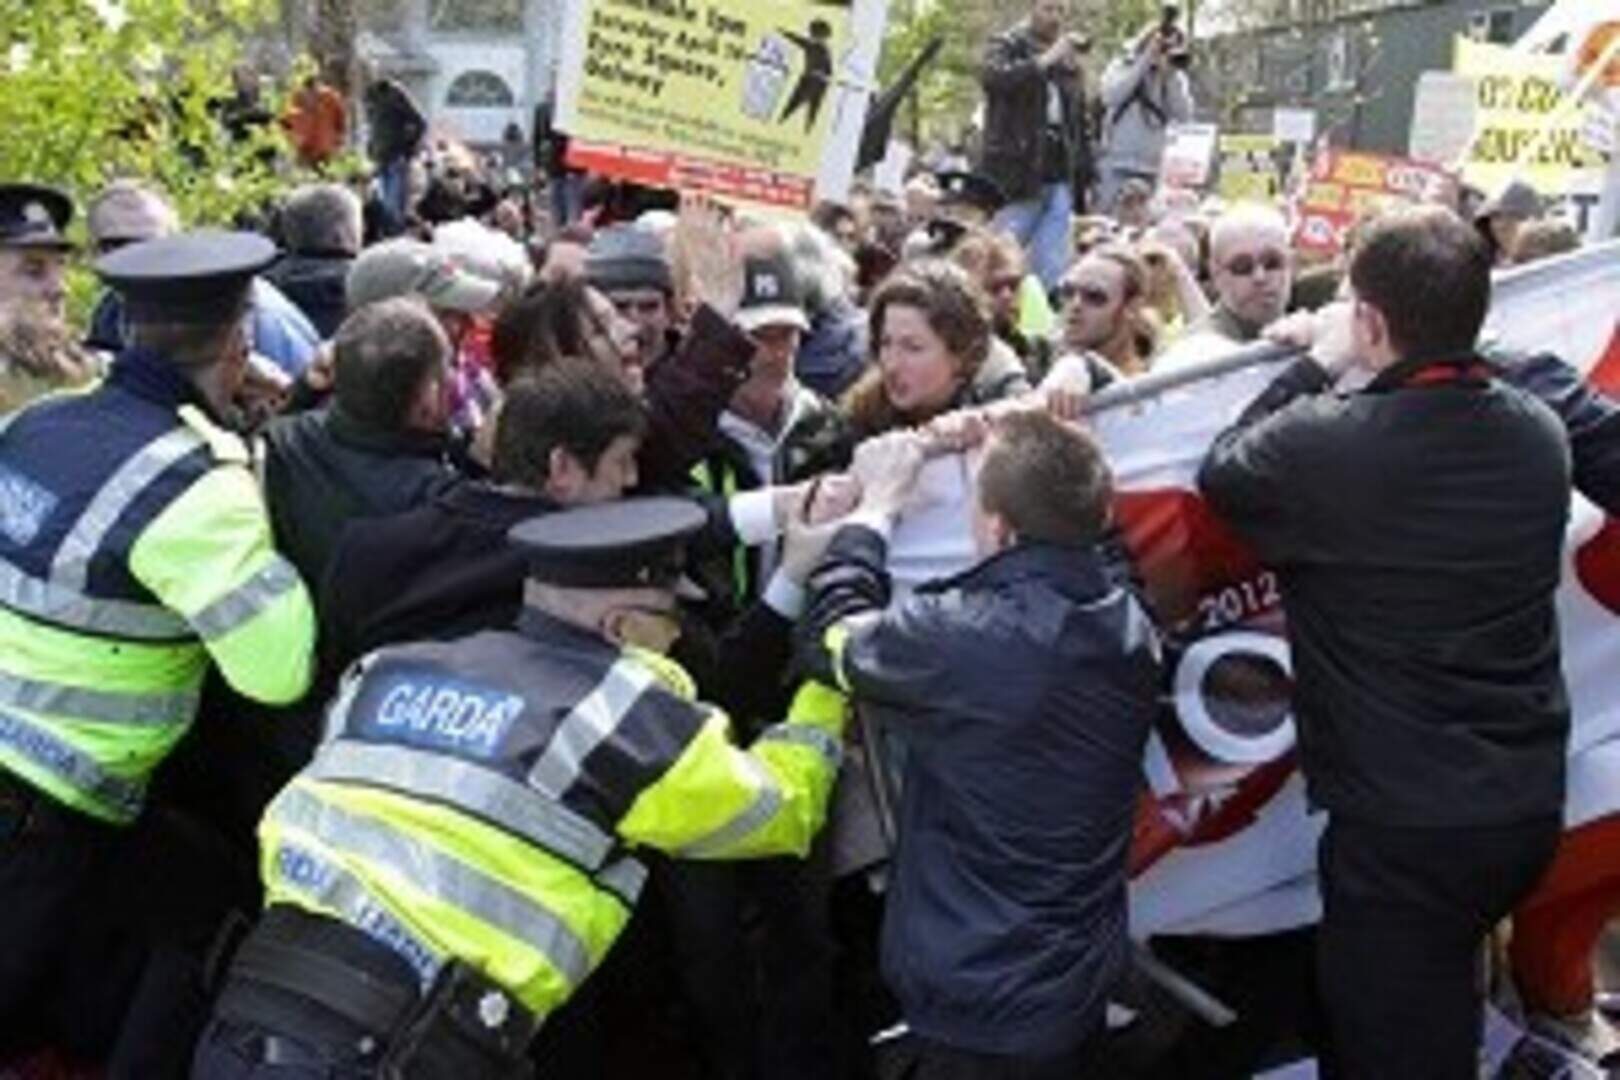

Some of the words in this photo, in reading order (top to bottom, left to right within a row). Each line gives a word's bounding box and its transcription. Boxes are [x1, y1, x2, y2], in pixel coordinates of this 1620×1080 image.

[585, 54, 664, 97] Galway
[1198, 571, 1281, 628] 2012
[377, 682, 521, 757] GARDA
